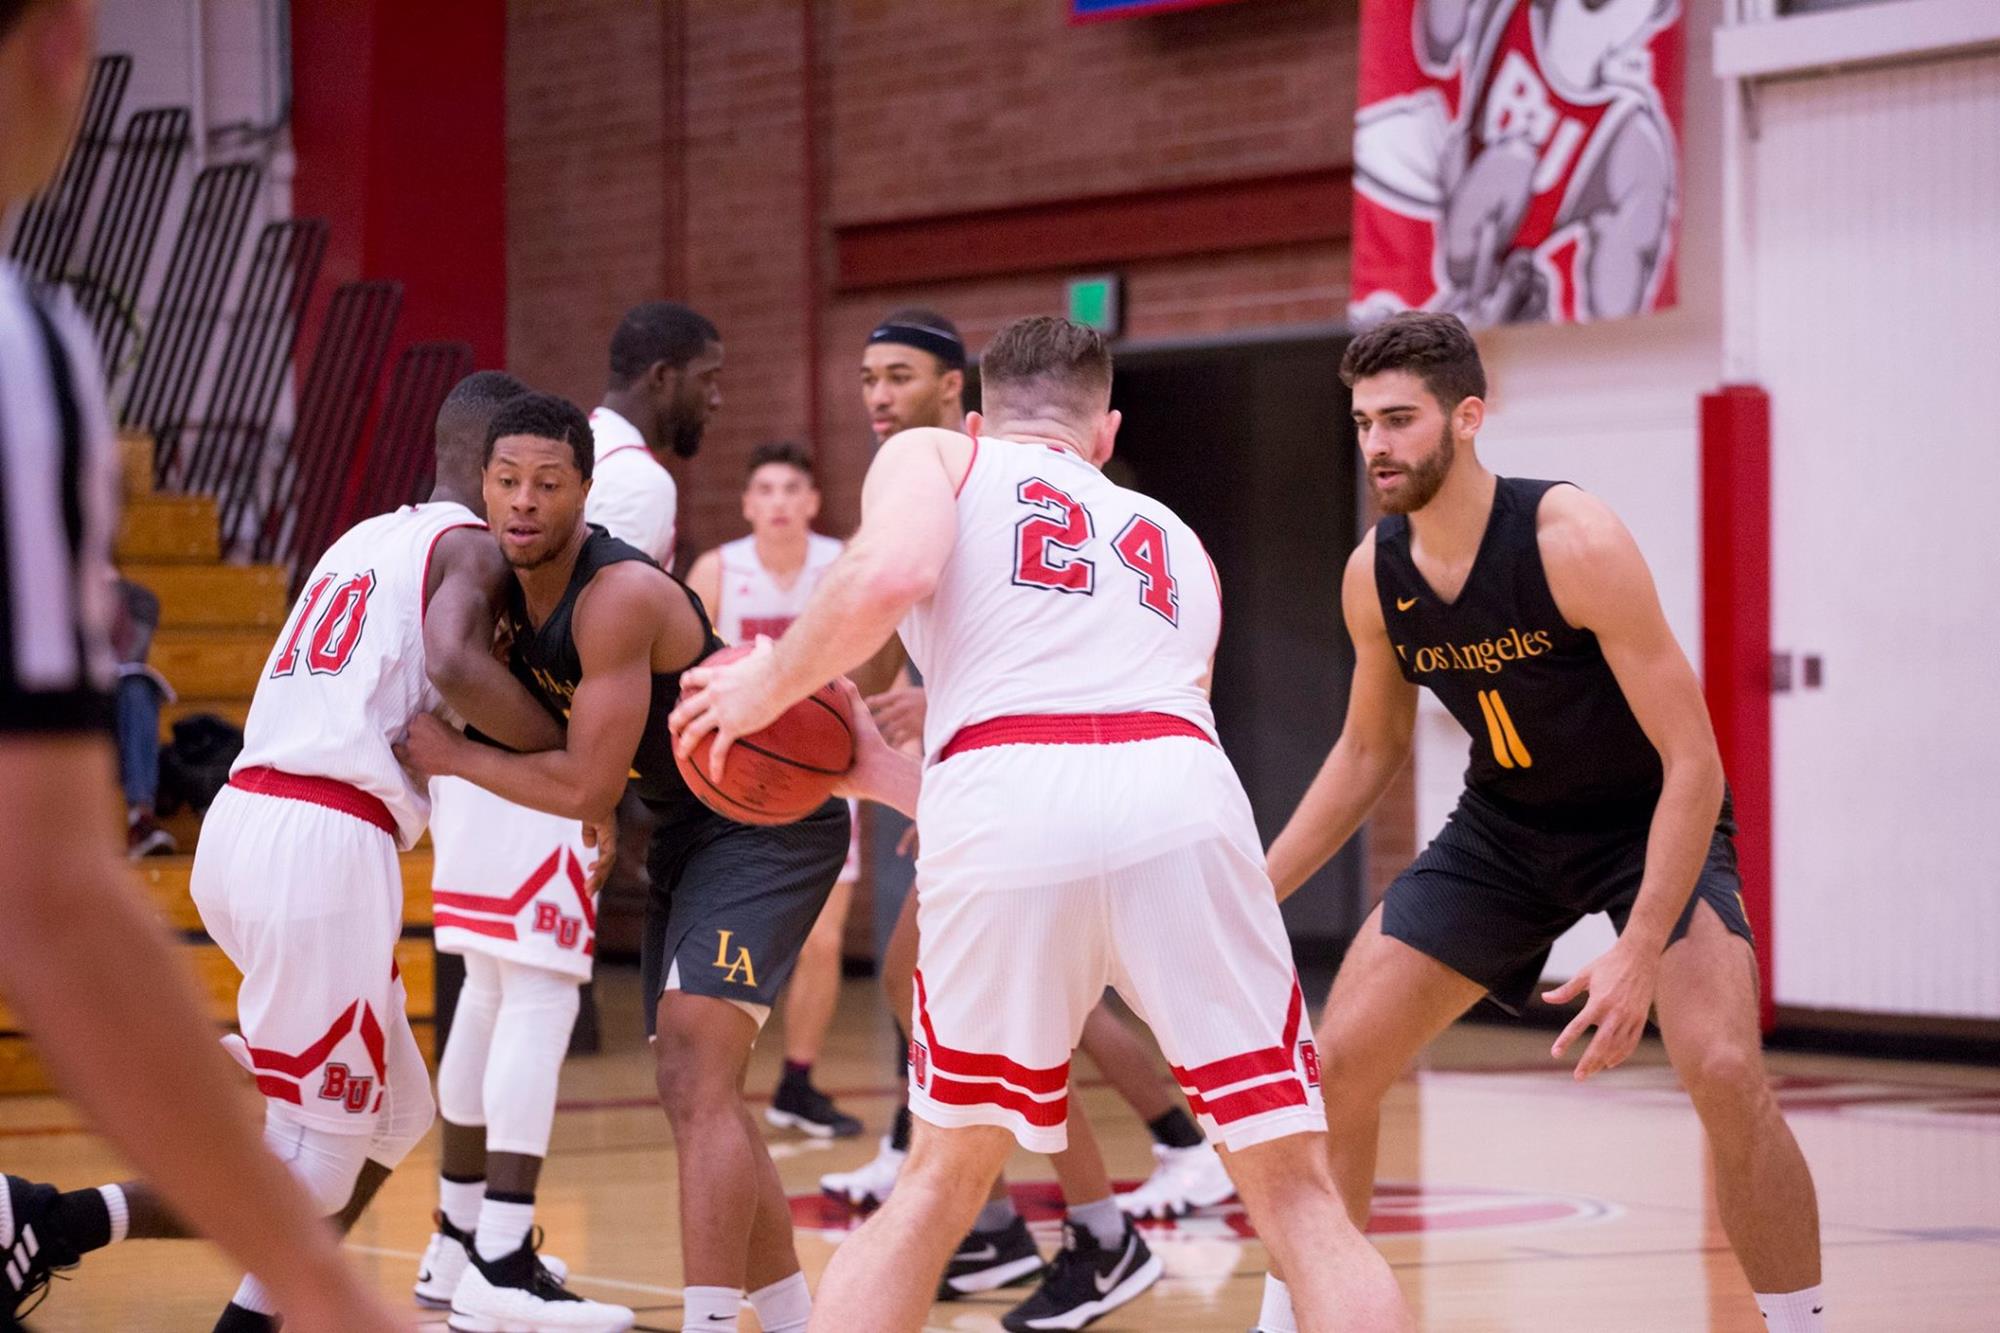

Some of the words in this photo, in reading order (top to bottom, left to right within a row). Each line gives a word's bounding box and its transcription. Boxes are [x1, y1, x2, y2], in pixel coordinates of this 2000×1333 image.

[1012, 476, 1179, 629] 24
[271, 568, 377, 679] 10
[1445, 627, 1553, 674] Angeles
[1478, 689, 1533, 769] 11
[532, 900, 582, 950] BU
[712, 929, 758, 988] LA
[318, 1062, 374, 1113] BU
